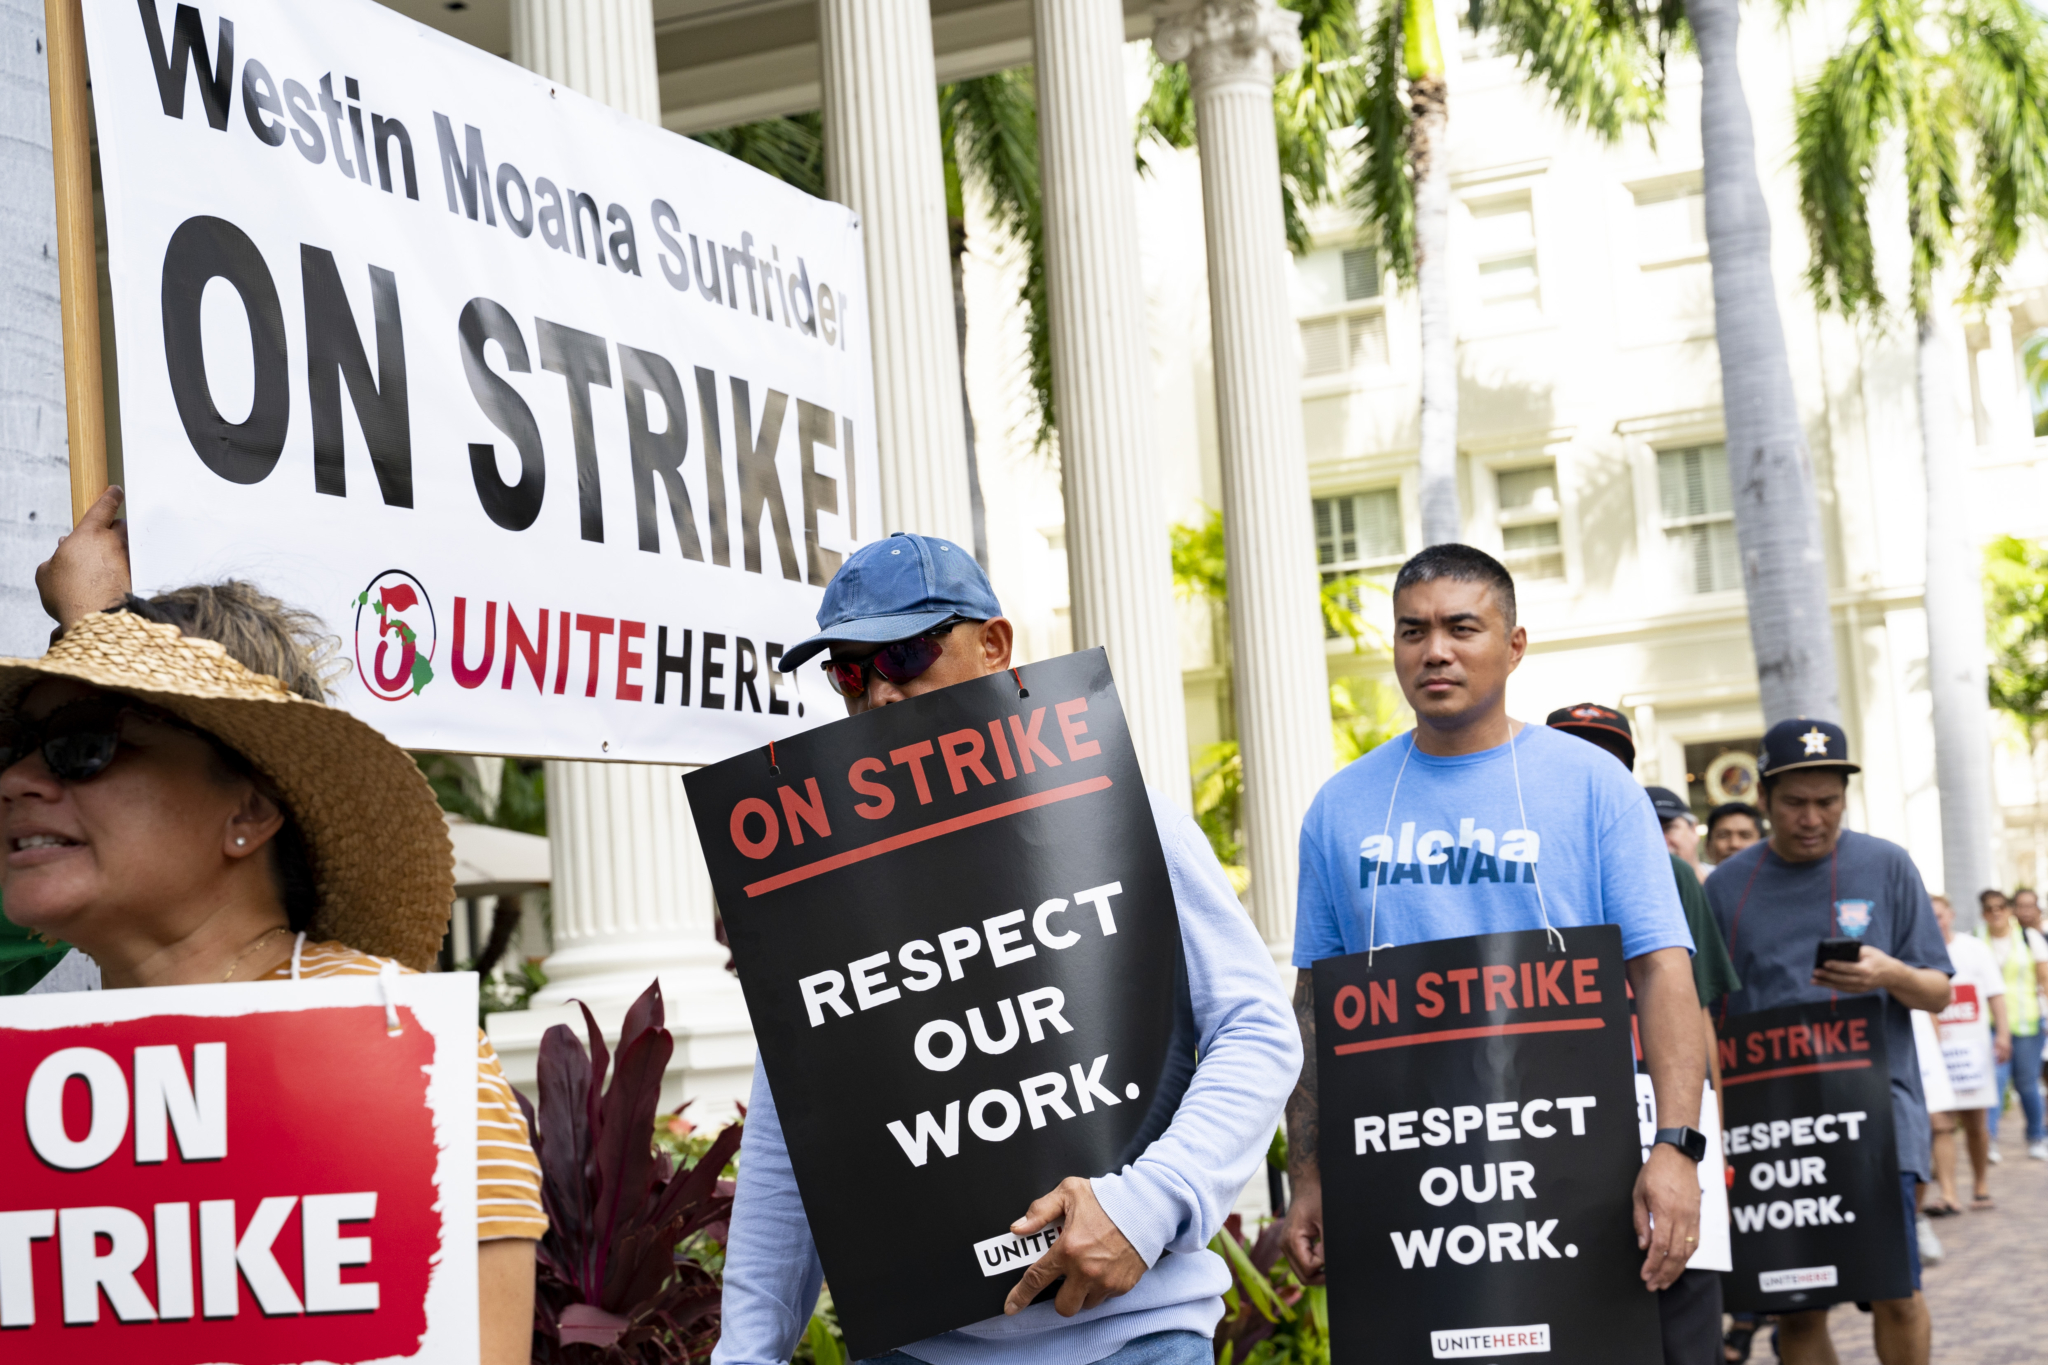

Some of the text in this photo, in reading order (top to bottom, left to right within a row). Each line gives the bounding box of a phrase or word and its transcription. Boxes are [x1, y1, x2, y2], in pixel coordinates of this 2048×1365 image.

[137, 0, 848, 352] Westin Moana Surfrider
[161, 214, 859, 588] ON STRIKE!
[729, 696, 1102, 860] ON STRIKE
[1359, 817, 1541, 866] aloha
[799, 880, 1124, 1028] RESPECT
[1333, 957, 1603, 1031] ON STRIKE
[914, 986, 1074, 1072] OUR
[1745, 1017, 1871, 1065] STRIKE
[24, 1042, 228, 1173] ON
[886, 1054, 1141, 1168] WORK.
[1354, 1095, 1597, 1155] RESPECT
[1419, 1161, 1537, 1207] OUR
[1749, 1155, 1828, 1192] OUR
[983, 1226, 1063, 1267] UNITE
[1390, 1218, 1579, 1270] WORK.
[1732, 1194, 1856, 1234] WORK.
[0, 1192, 380, 1330] TRIKE
[1437, 1331, 1545, 1352] UNITEHERE!
